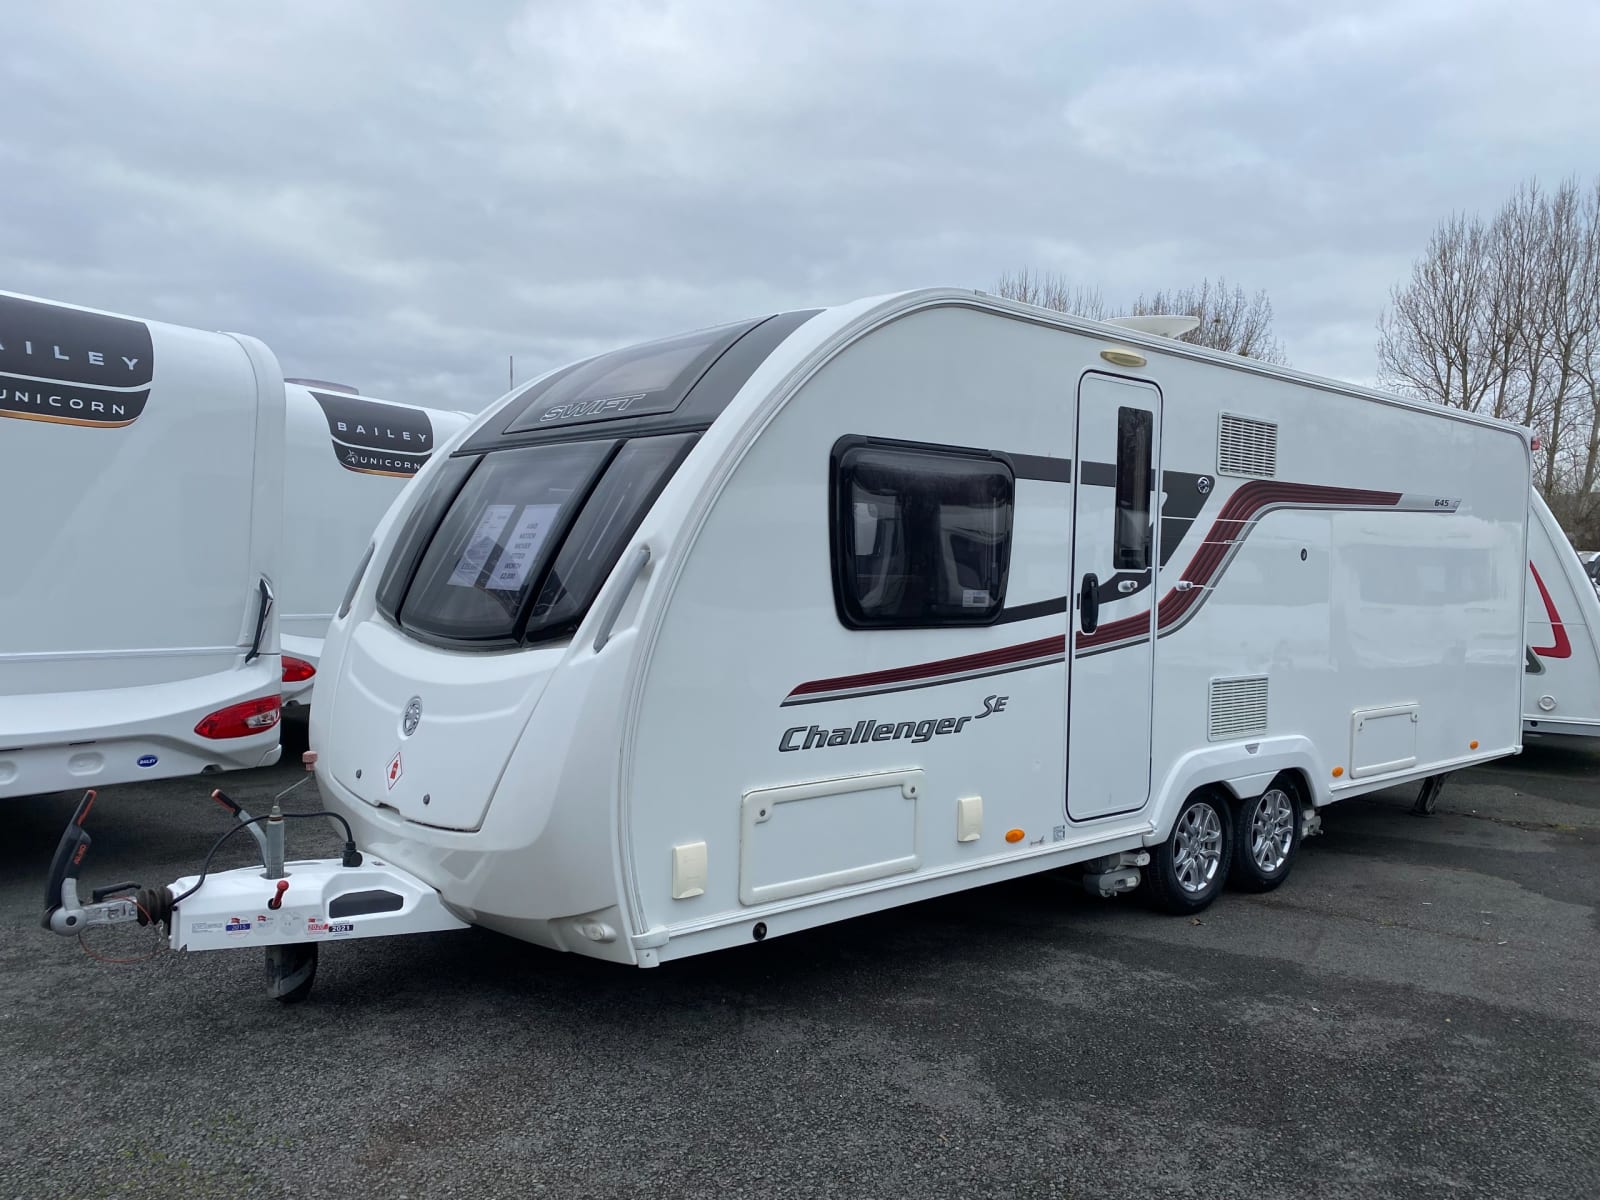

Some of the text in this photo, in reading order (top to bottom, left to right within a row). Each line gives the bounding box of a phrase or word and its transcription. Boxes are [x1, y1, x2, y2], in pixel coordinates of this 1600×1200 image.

[539, 393, 647, 422] SWIFT
[337, 421, 427, 443] BAILEY
[360, 456, 420, 469] UNICORN
[1434, 499, 1450, 507] 645
[778, 694, 1009, 752] Challenger SE
[332, 924, 350, 932] 2021
